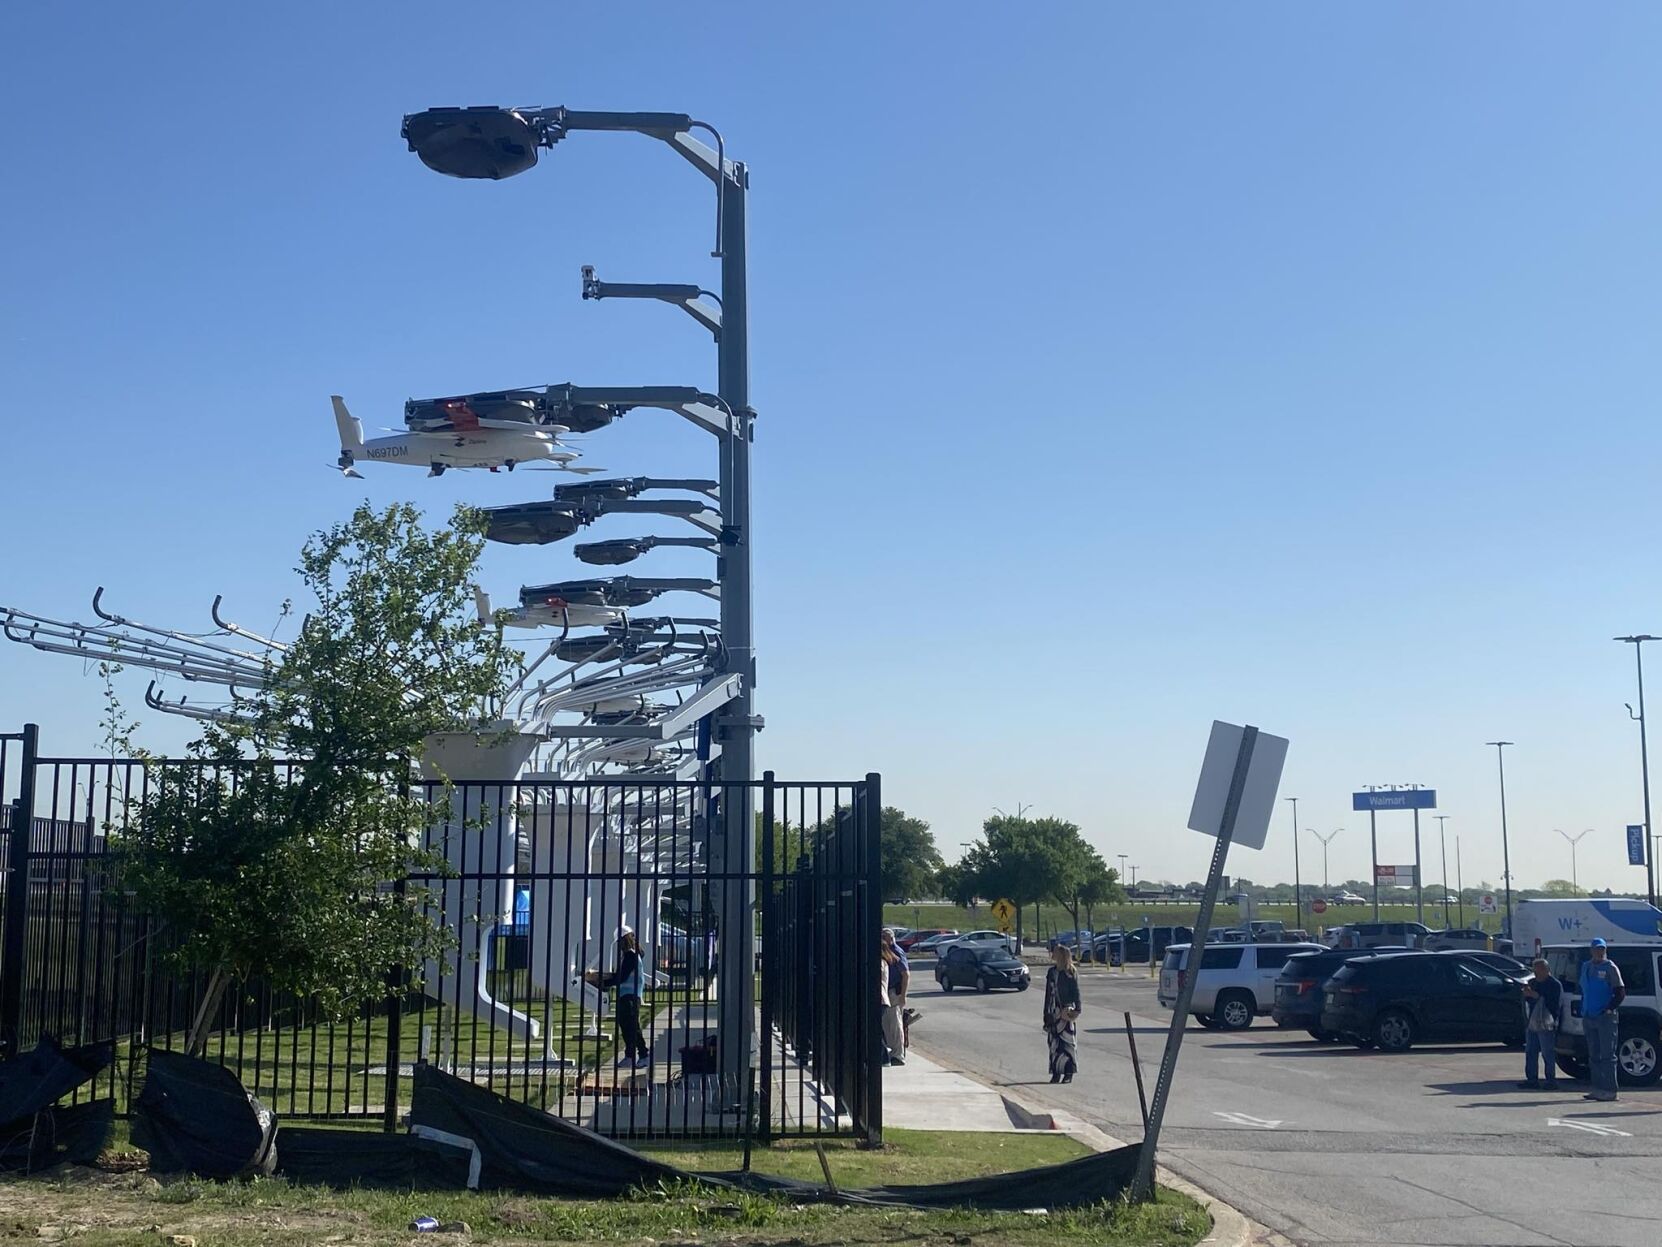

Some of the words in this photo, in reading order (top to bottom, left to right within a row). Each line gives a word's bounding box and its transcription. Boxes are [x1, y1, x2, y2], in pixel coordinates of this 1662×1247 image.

[366, 446, 409, 459] N697DM
[1369, 796, 1406, 806] Walmart
[1630, 828, 1640, 861] Pickup
